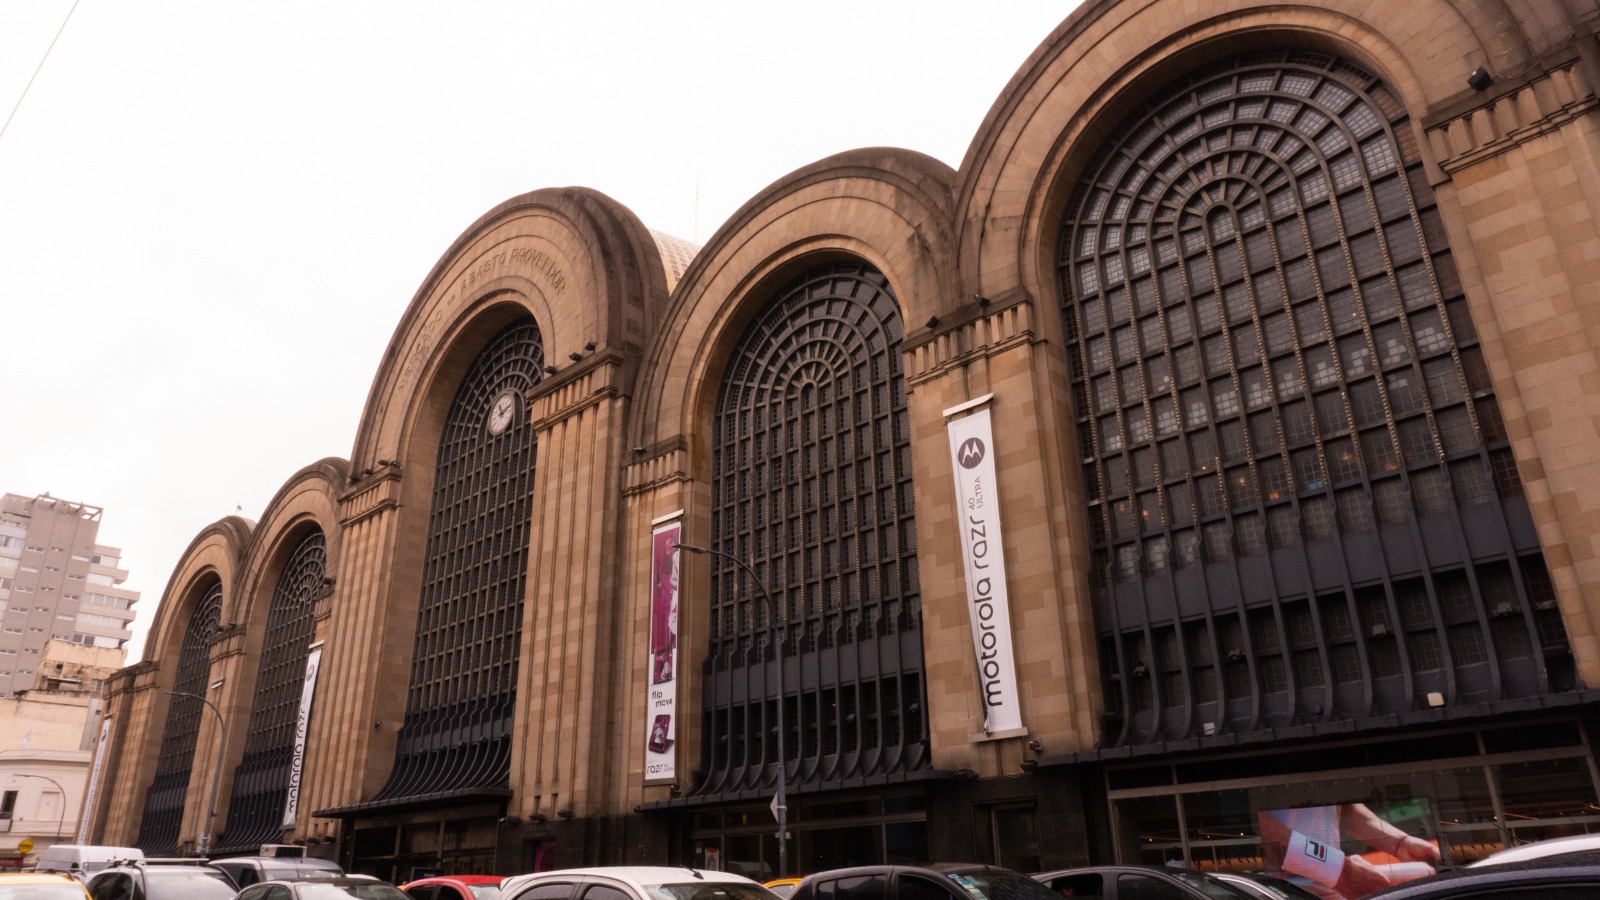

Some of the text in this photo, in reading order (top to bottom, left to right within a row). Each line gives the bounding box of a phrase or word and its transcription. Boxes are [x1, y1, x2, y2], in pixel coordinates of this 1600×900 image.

[460, 251, 507, 294] ABASTO
[509, 247, 566, 295] PROVEEDOR
[974, 475, 984, 509] ULTRA
[967, 497, 976, 510] 40
[969, 515, 1003, 707] motorola razr
[651, 690, 663, 700] flip
[655, 698, 673, 708] move
[646, 764, 663, 774] razr
